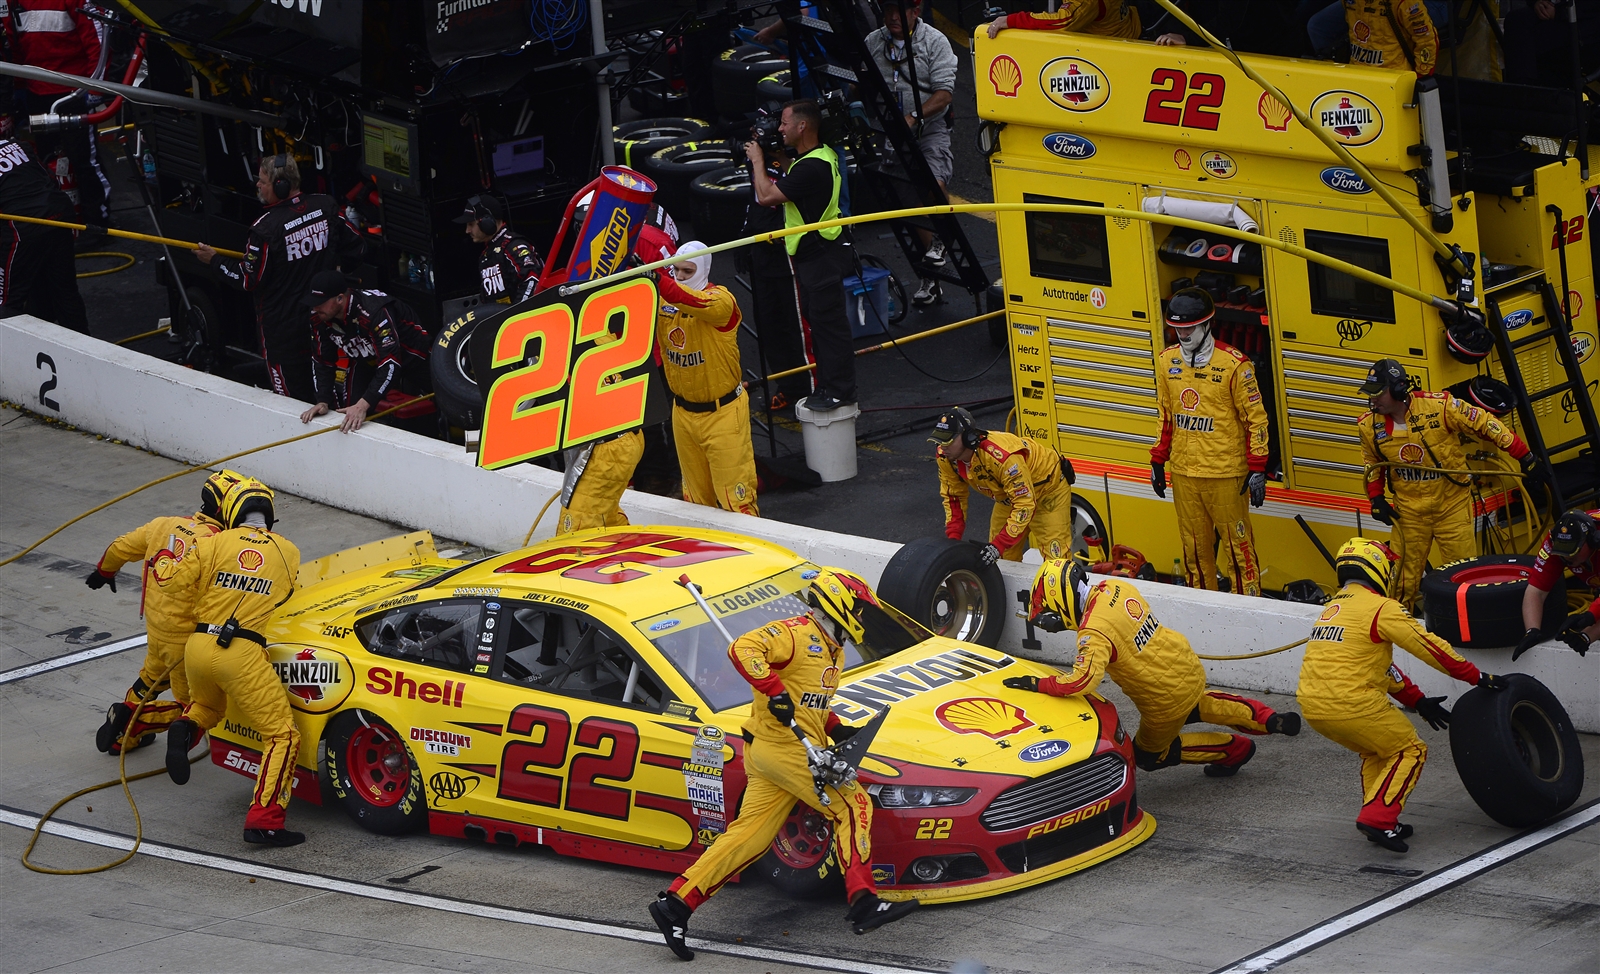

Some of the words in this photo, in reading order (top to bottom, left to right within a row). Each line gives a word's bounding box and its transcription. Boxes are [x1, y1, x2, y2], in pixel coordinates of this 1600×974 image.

[1050, 74, 1100, 93] PENNZOIL
[1143, 67, 1226, 131] 22
[1321, 108, 1373, 127] PENNZOIL
[1053, 135, 1086, 157] Ford
[0, 149, 30, 177] OW
[1205, 159, 1232, 170] PENNZOIL
[1331, 169, 1364, 191] Ford
[285, 220, 329, 245] FURNITURE
[287, 230, 329, 262] ROW
[1042, 286, 1089, 303] Autotrader
[438, 310, 476, 348] EAGLE
[1012, 322, 1040, 332] DISCOUNT
[1506, 311, 1528, 329] Ford
[1017, 344, 1040, 356] Hertz
[480, 277, 657, 470] 22
[1019, 363, 1041, 374] SKF
[36, 351, 60, 412] 2
[1436, 556, 1479, 571] EAGLE
[215, 571, 274, 596] PENNZOIL
[378, 593, 419, 609] AutoZone
[522, 592, 550, 602] JOEY
[550, 595, 590, 611] LOGANO
[712, 584, 781, 615] LOGANO
[322, 625, 353, 639] SKF
[1132, 613, 1160, 654] PENNZ
[366, 666, 466, 708] Shell
[829, 648, 1017, 723] ENNZOIL
[224, 718, 262, 743] Autotra
[410, 727, 472, 749] DISCOUNT
[428, 743, 456, 755] TIRE
[1029, 744, 1062, 760] Ford
[325, 747, 346, 799] EAGLE
[496, 703, 640, 822] 22
[682, 762, 723, 776] MOOG
[430, 771, 468, 800] AAA
[688, 787, 723, 804] MAHLE
[695, 782, 721, 792] freescale
[693, 801, 720, 812] LINCOLN
[700, 810, 723, 819] WELDERS
[915, 818, 953, 840] 22
[1027, 799, 1110, 840] FUSION
